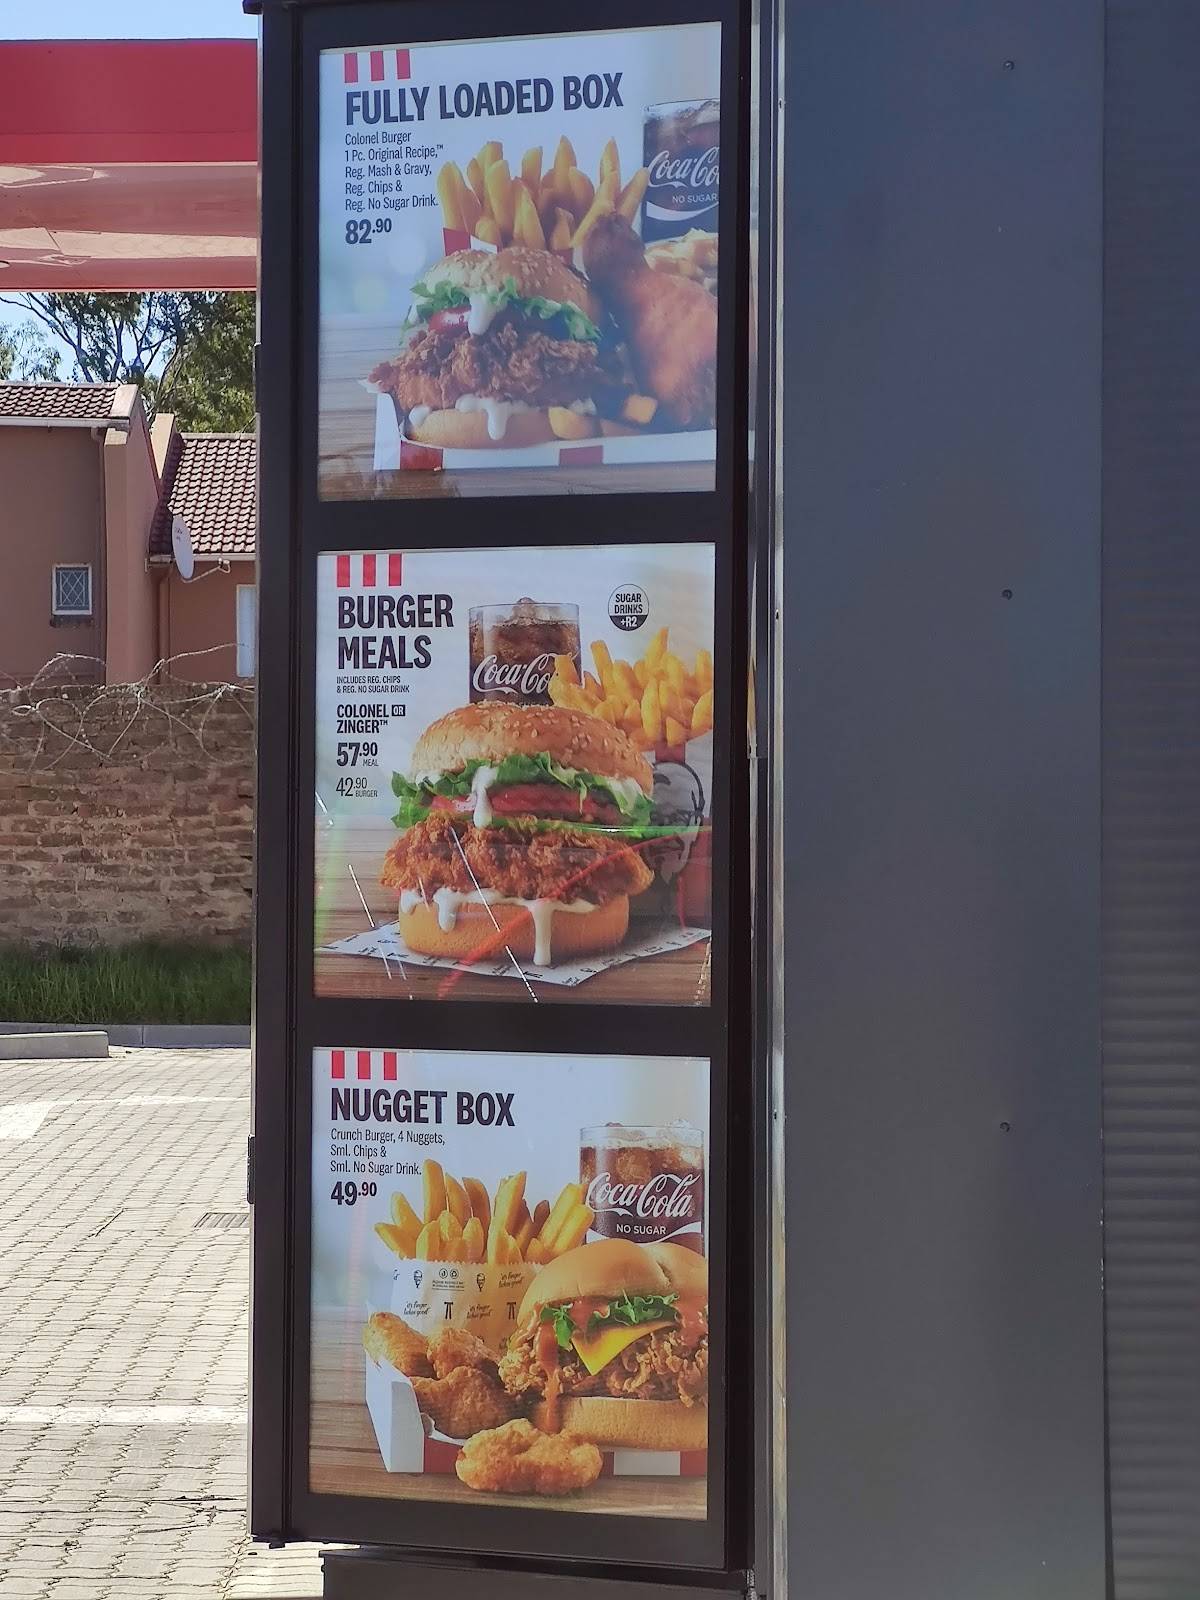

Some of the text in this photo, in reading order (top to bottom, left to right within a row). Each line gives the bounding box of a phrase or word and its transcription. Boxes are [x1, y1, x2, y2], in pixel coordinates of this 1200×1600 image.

[346, 72, 624, 126] FULLY LOADED BOX
[345, 131, 411, 146] Colonel Burger
[345, 150, 349, 162] 1
[352, 149, 365, 162] Pc.
[368, 146, 402, 163] Original
[345, 163, 432, 180] Reg. Mash & Gravy,
[648, 146, 719, 188] Coca-Co
[345, 179, 402, 196] Reg. Chips &
[345, 194, 439, 213] Reg. No Sugar Drink.
[672, 193, 718, 204] NO SUGAR
[345, 217, 392, 245] 82.90
[615, 593, 642, 603] SUGAR
[338, 593, 454, 629] BURGER
[614, 604, 643, 614] DRINKS
[620, 616, 638, 627] +R2
[338, 634, 432, 670] MEALS
[336, 675, 401, 684] INCLUDES REG. CHIPS
[472, 653, 555, 694] Coca-Co
[336, 684, 410, 694] & REG. NO SUGAR DRINK
[336, 704, 404, 718] COLONEL OR
[336, 742, 379, 767] 57.90 MEAL
[335, 777, 368, 797] 42.90
[331, 1087, 515, 1127] NUGGET BOX
[331, 1127, 445, 1146] Crunch Burger, 4 Nuggets,
[330, 1144, 387, 1160] Sml. Chips &
[330, 1159, 422, 1176] Sml. No Sugar Drink.
[330, 1181, 377, 1206] 49.90
[585, 1171, 700, 1218] Coca-Cola
[616, 1223, 667, 1235] NO SUGAR
